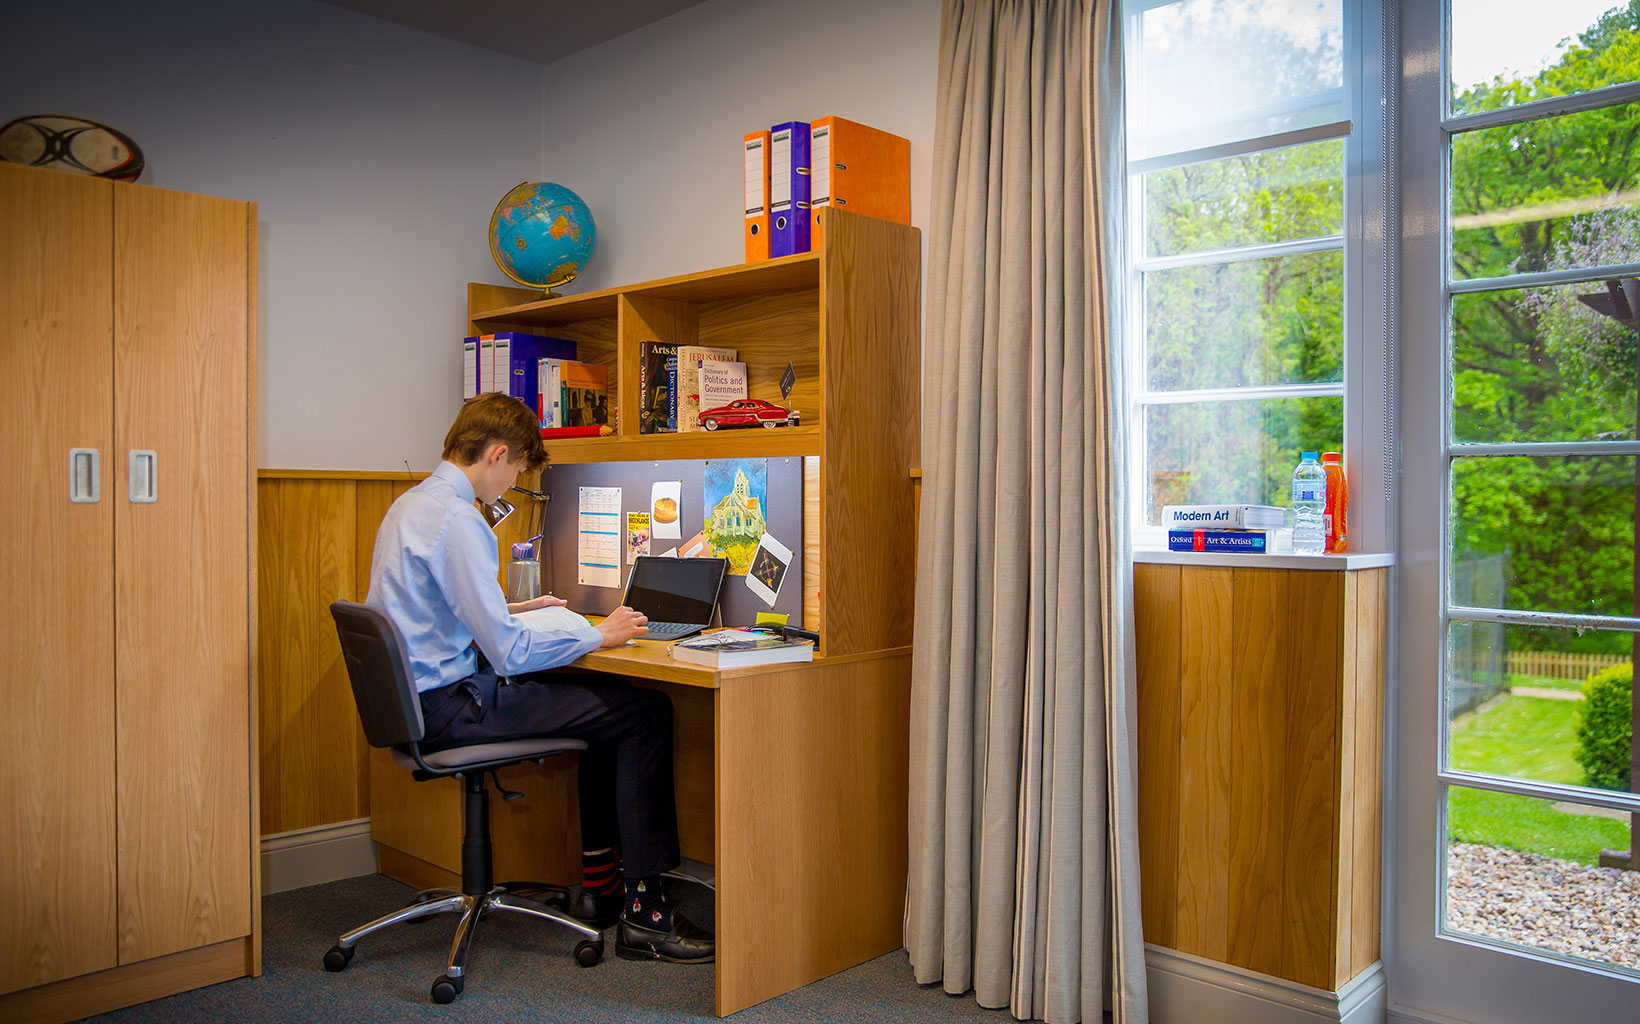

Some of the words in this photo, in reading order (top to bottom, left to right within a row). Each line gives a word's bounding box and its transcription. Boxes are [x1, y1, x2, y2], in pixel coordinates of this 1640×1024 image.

[652, 345, 669, 354] Arts
[670, 347, 677, 355] &
[689, 352, 734, 362] JERUSALEM
[704, 375, 728, 384] Politics
[730, 377, 743, 385] and
[704, 384, 743, 394] Government
[1173, 511, 1211, 521] Modern
[1214, 510, 1229, 520] Art
[1229, 537, 1252, 545] Artists
